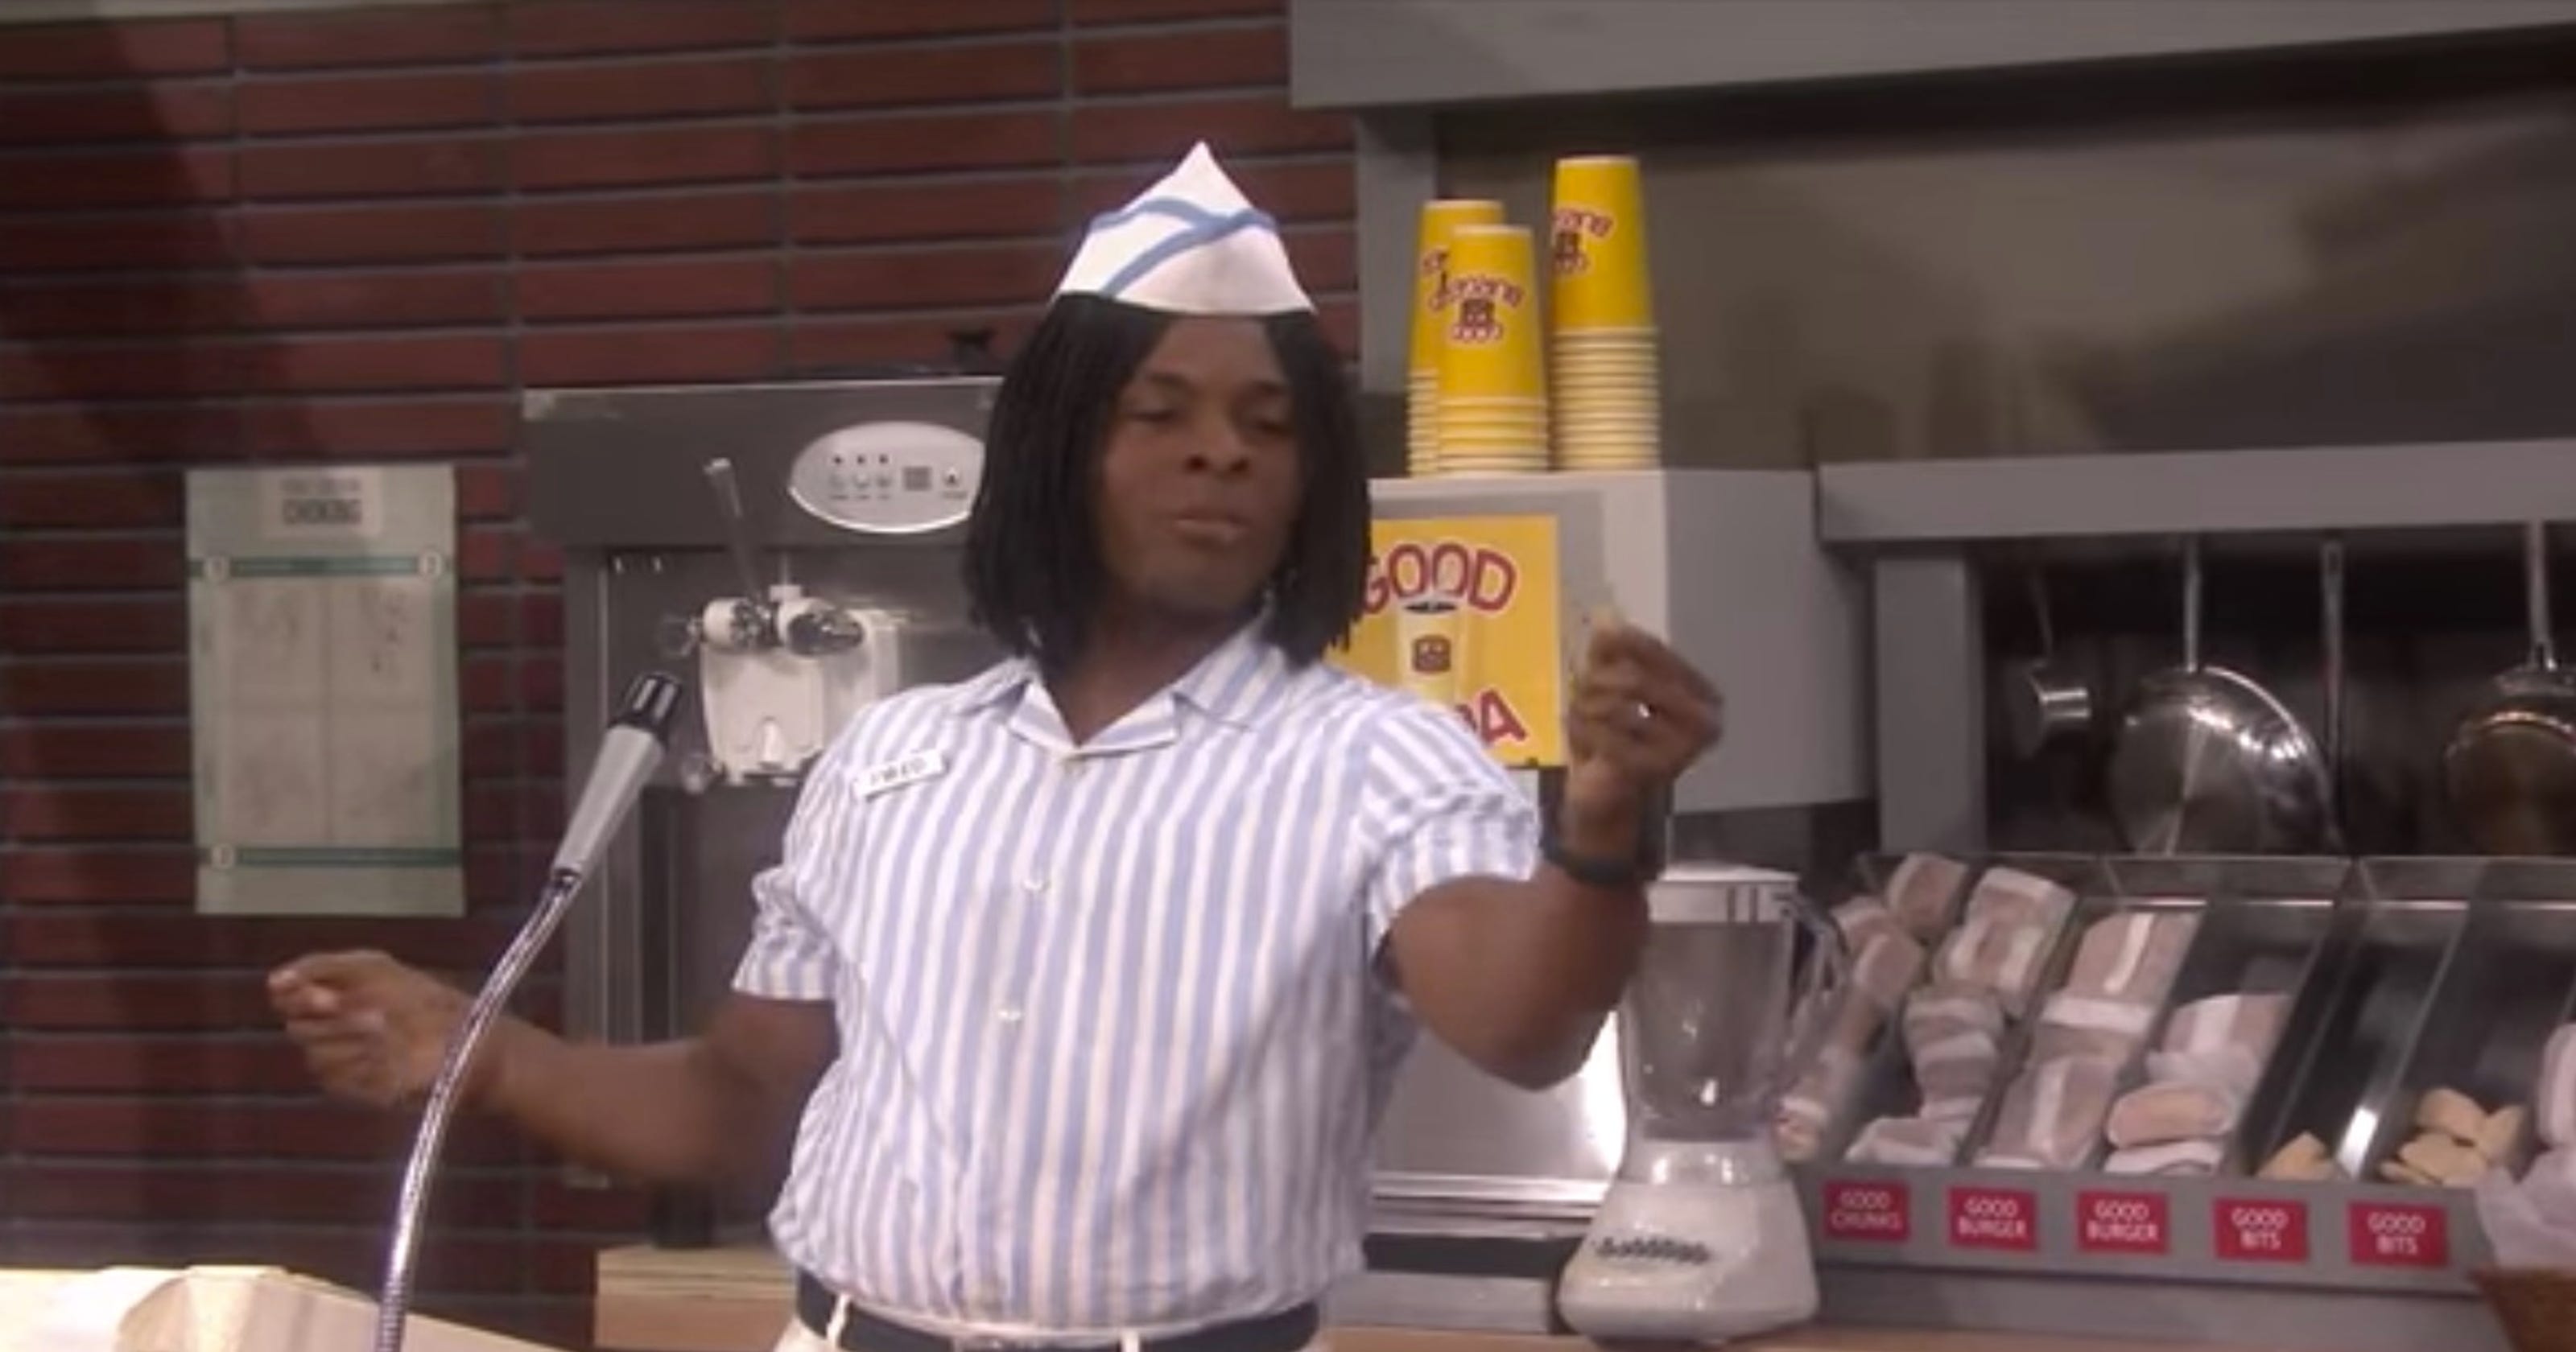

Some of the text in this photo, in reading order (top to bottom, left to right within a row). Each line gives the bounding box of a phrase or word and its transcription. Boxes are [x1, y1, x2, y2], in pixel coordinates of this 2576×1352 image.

[1840, 1190, 1890, 1209] GOOD
[1965, 1197, 2018, 1217] GOOD
[2095, 1200, 2149, 1221] GOOD
[2231, 1207, 2289, 1229] GOOD
[1959, 1216, 2027, 1239] BURGER
[2087, 1220, 2158, 1242] BURGER
[2368, 1211, 2426, 1234] GOOD
[2240, 1230, 2281, 1250] BITS
[2377, 1235, 2417, 1255] BITS
